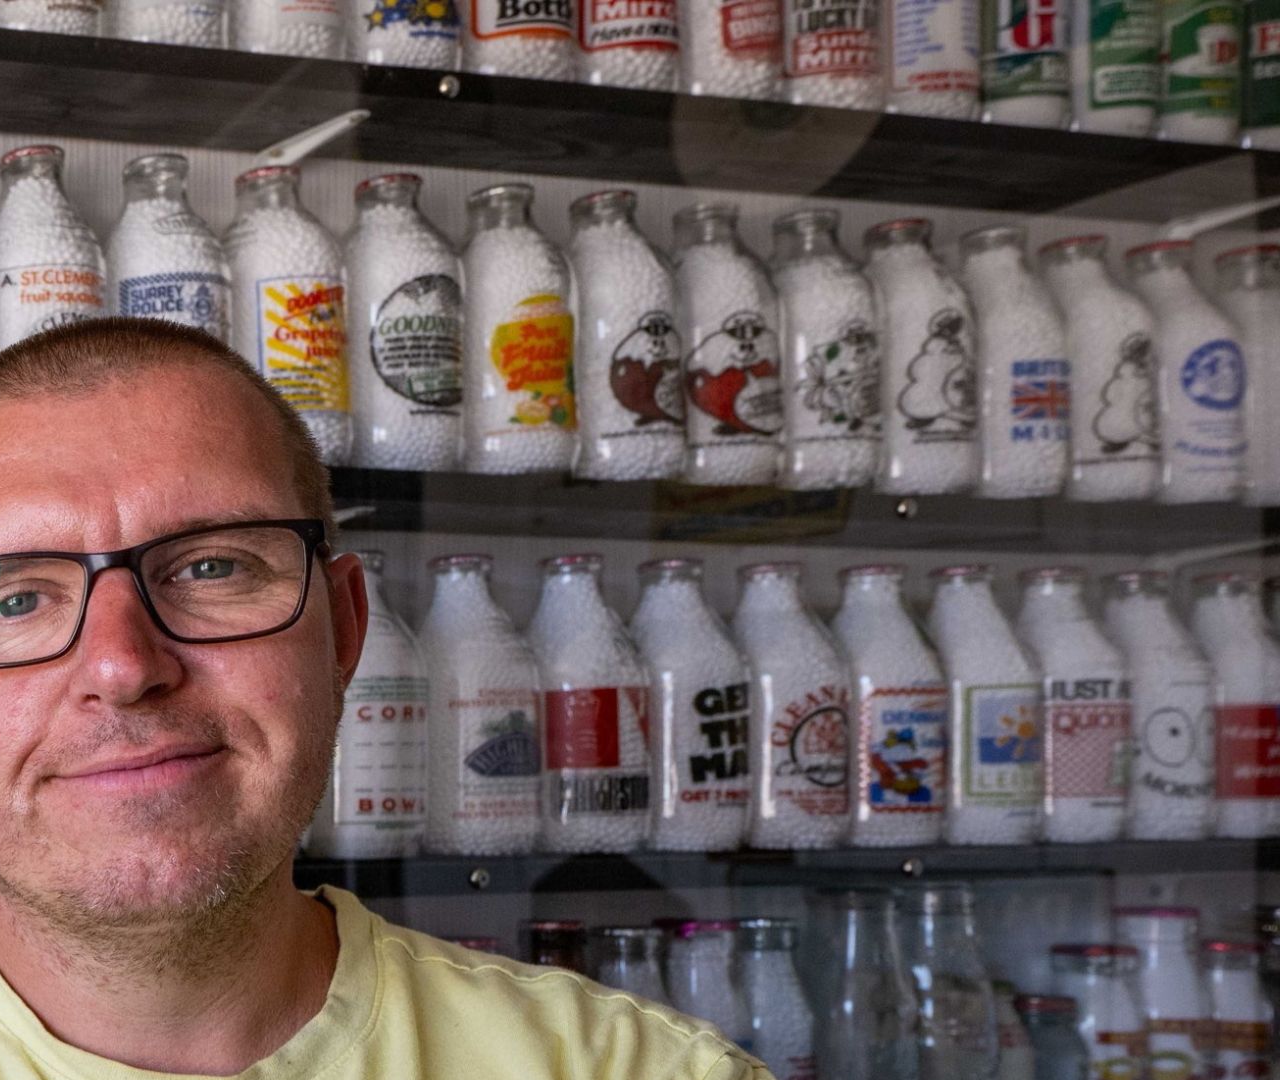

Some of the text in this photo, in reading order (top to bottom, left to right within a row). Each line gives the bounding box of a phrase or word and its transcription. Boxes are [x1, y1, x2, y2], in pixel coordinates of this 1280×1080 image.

[130, 285, 181, 301] SURREY
[130, 299, 183, 315] POLICE
[692, 681, 750, 717] GE
